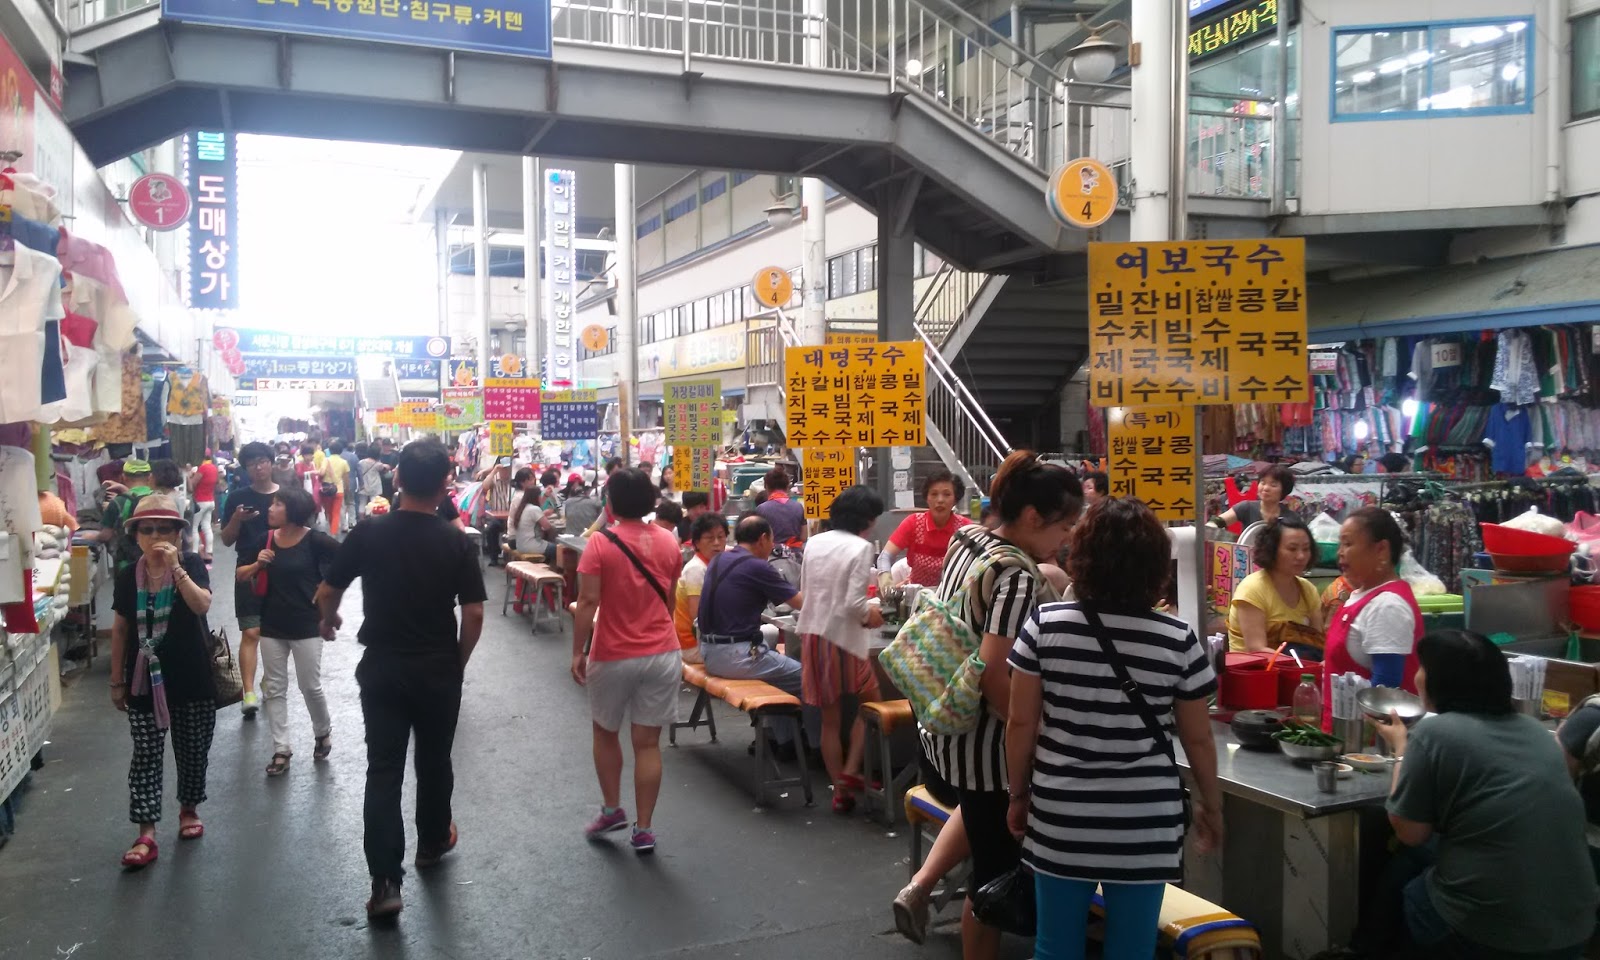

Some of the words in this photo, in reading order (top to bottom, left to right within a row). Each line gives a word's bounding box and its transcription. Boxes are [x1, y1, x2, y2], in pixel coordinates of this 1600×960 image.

[410, 0, 473, 25] 침구류
[483, 8, 523, 31] 커텐
[155, 207, 164, 224] 1
[198, 175, 231, 301] 도매상가
[1081, 200, 1092, 220] 4
[1116, 244, 1285, 279] 여보국수
[771, 292, 778, 304] 4
[803, 346, 905, 367] 대명국수
[1095, 289, 1125, 403] 밀수제비
[1129, 289, 1160, 402] 잔치국수
[1165, 288, 1195, 401] 비빔국수
[1236, 288, 1268, 400] 콩국수
[1271, 287, 1304, 399] 칼국수
[789, 376, 808, 445] 잔치국수
[811, 376, 830, 445] 칼국수
[833, 375, 852, 445] 비빔국수
[880, 374, 899, 444] 콩국수
[902, 373, 922, 444] 밀수제비
[1112, 436, 1138, 497] 찹쌀수제
[1169, 436, 1194, 516] 콩국수
